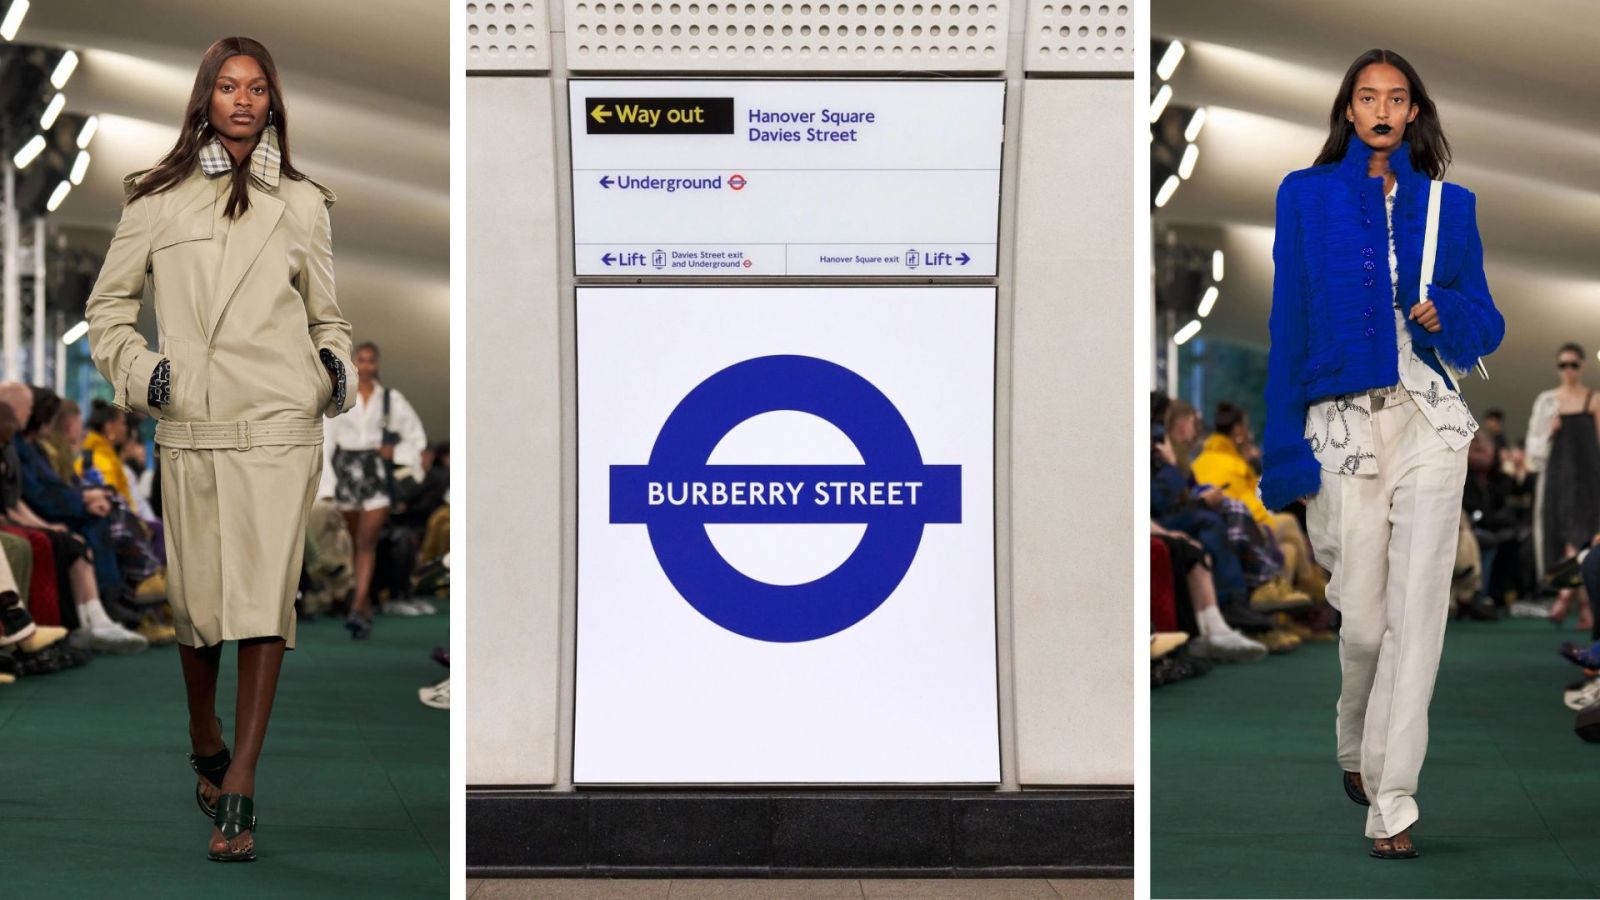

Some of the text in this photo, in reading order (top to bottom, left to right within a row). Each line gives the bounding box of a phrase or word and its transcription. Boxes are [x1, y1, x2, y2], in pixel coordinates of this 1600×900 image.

[615, 104, 704, 128] Way out
[748, 109, 875, 128] Hanover Square
[748, 127, 857, 142] Davies Street
[617, 175, 722, 193] Underground
[619, 253, 647, 267] Lift
[671, 251, 744, 259] Davies Street exit
[819, 255, 900, 265] Hanover Square exit
[925, 252, 952, 266] Lift
[688, 260, 741, 269] Underground
[648, 481, 923, 506] BURBERRY STREET
